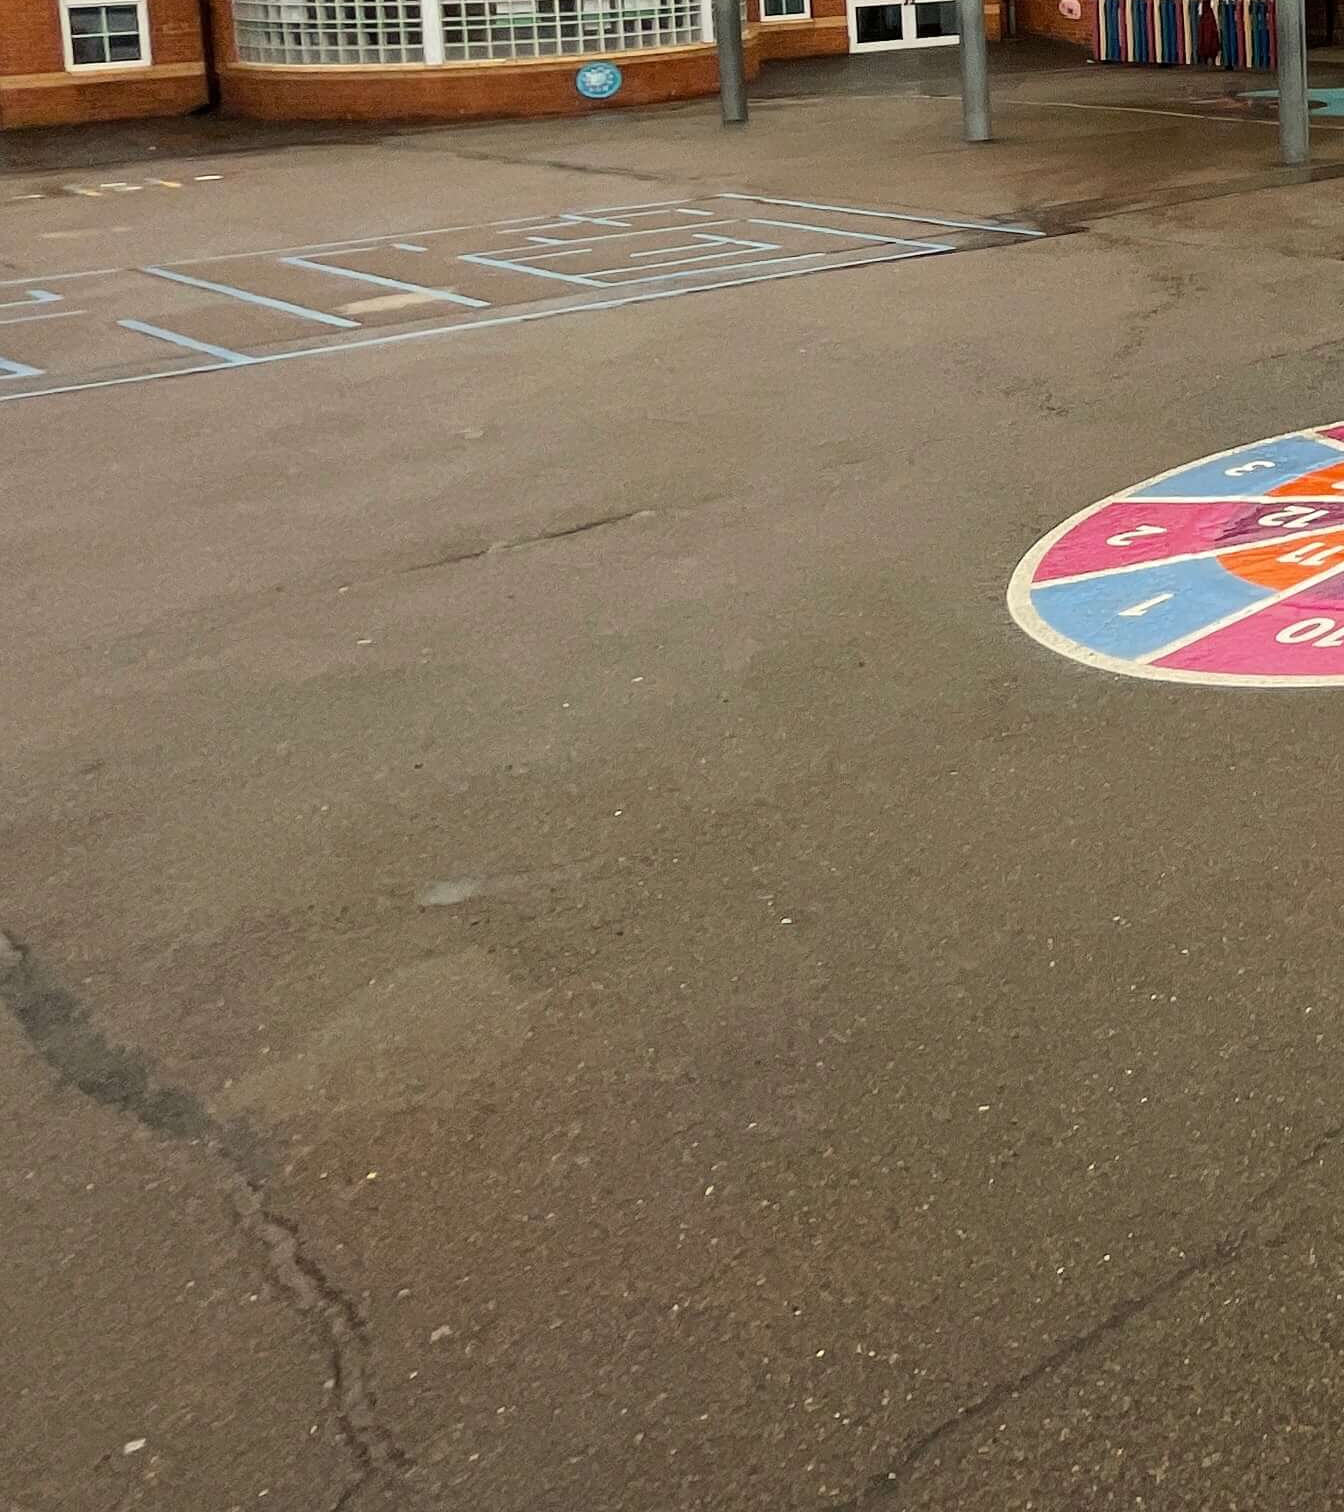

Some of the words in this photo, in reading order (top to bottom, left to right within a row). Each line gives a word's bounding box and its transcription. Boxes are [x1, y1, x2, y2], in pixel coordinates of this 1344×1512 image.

[1223, 460, 1276, 477] 3
[1258, 506, 1330, 529] 12
[1106, 525, 1168, 546] 2
[1118, 592, 1175, 617] 1
